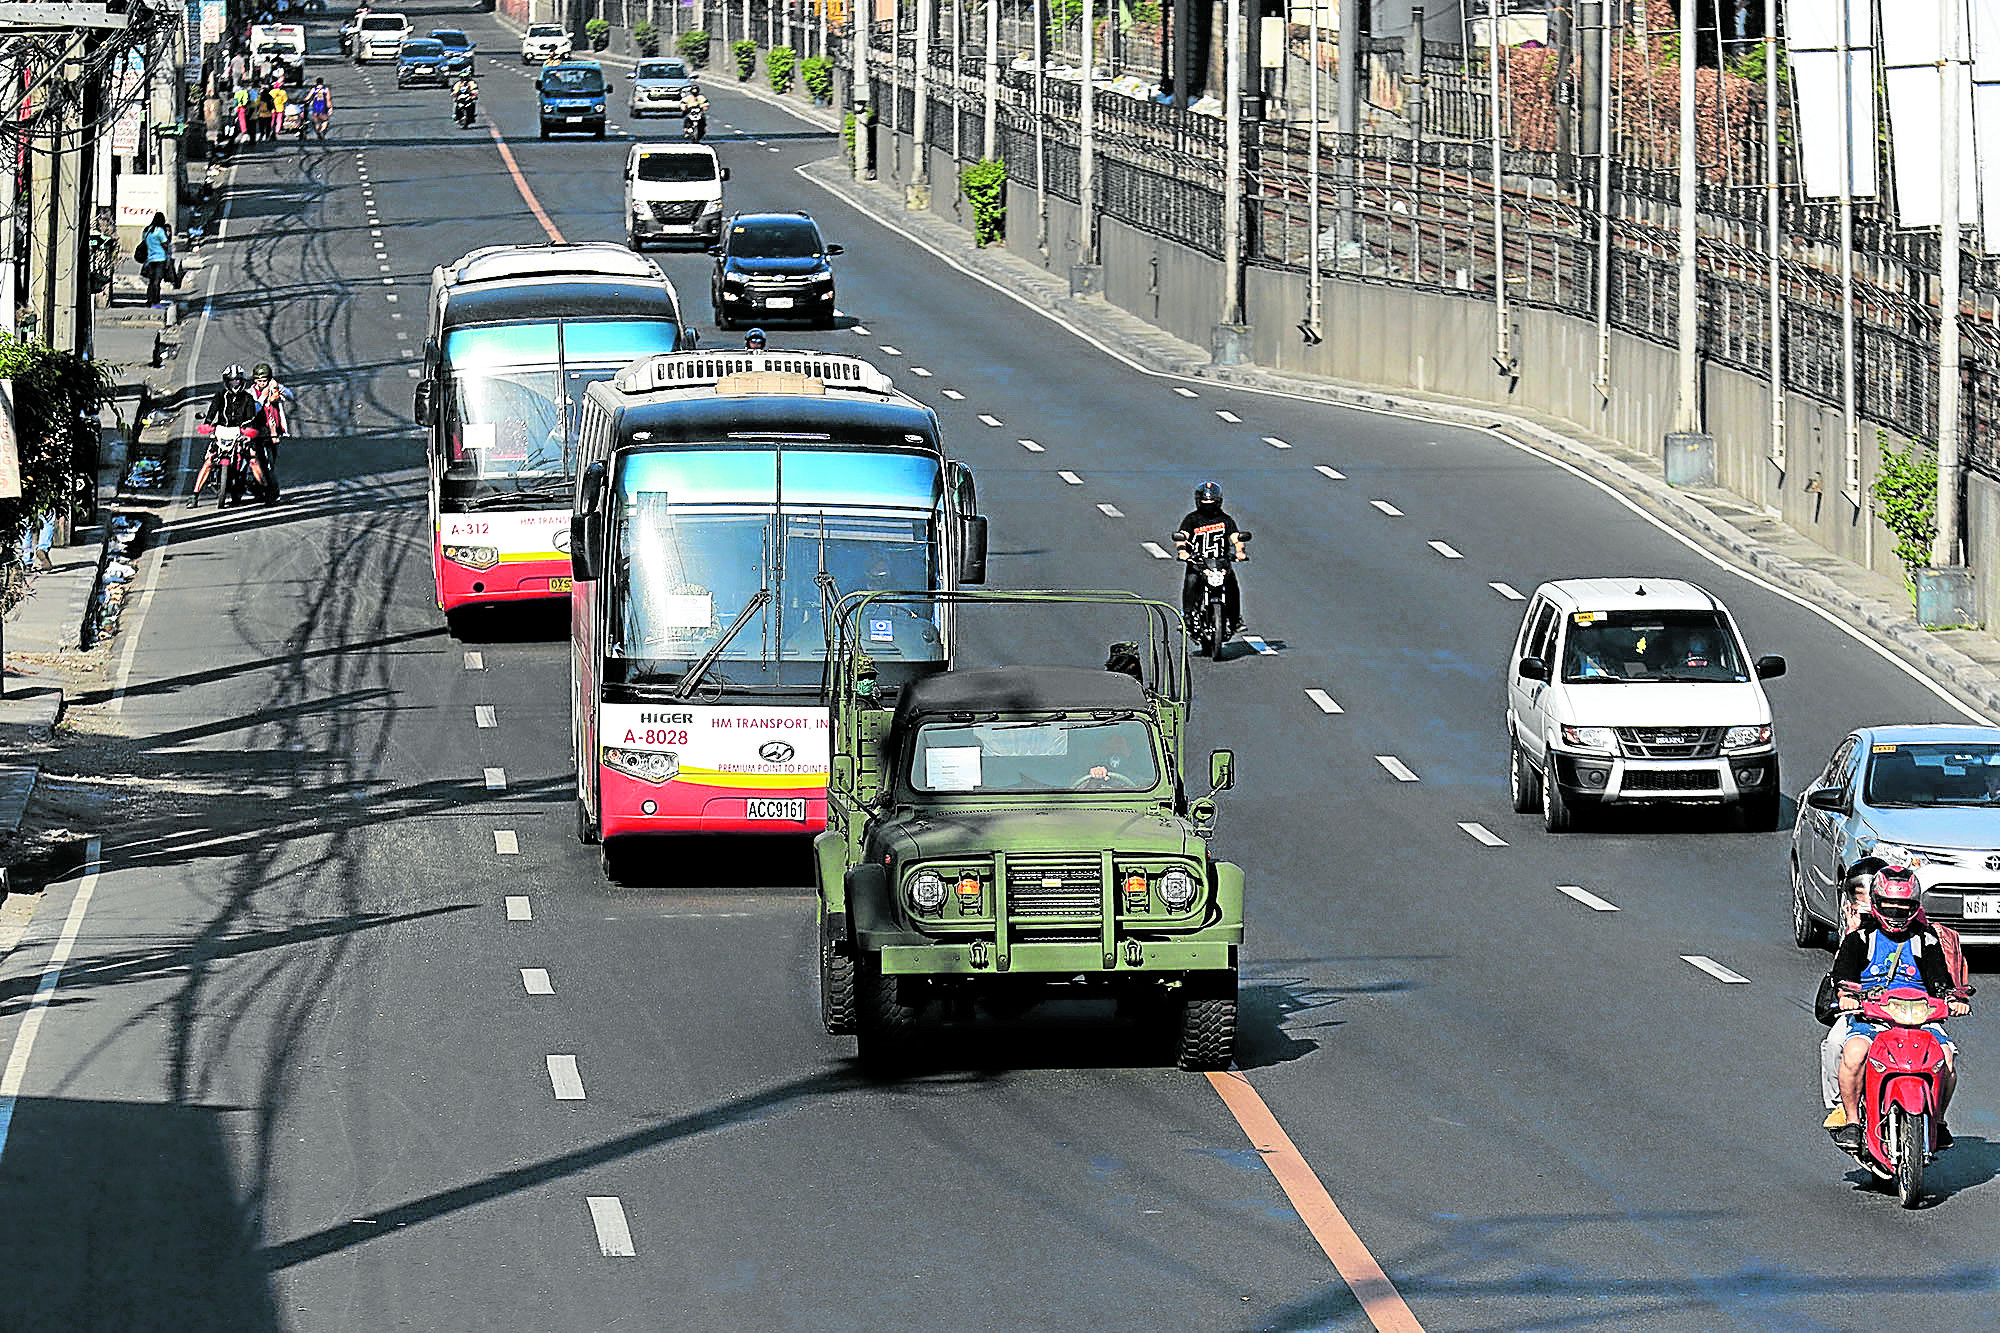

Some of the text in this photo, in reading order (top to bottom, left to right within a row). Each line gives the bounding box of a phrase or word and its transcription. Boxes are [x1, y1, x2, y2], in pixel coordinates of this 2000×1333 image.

[121, 205, 158, 216] TOTA
[451, 522, 489, 535] A-312
[640, 713, 693, 723] HIGER
[711, 718, 732, 729] HM
[623, 729, 688, 744] A-8028
[718, 763, 756, 773] PREMIUM
[757, 763, 782, 773] POINT
[784, 763, 795, 773] TO
[797, 763, 822, 773] POINT
[748, 801, 803, 818] ACC9161
[1966, 901, 1988, 914] NBM
